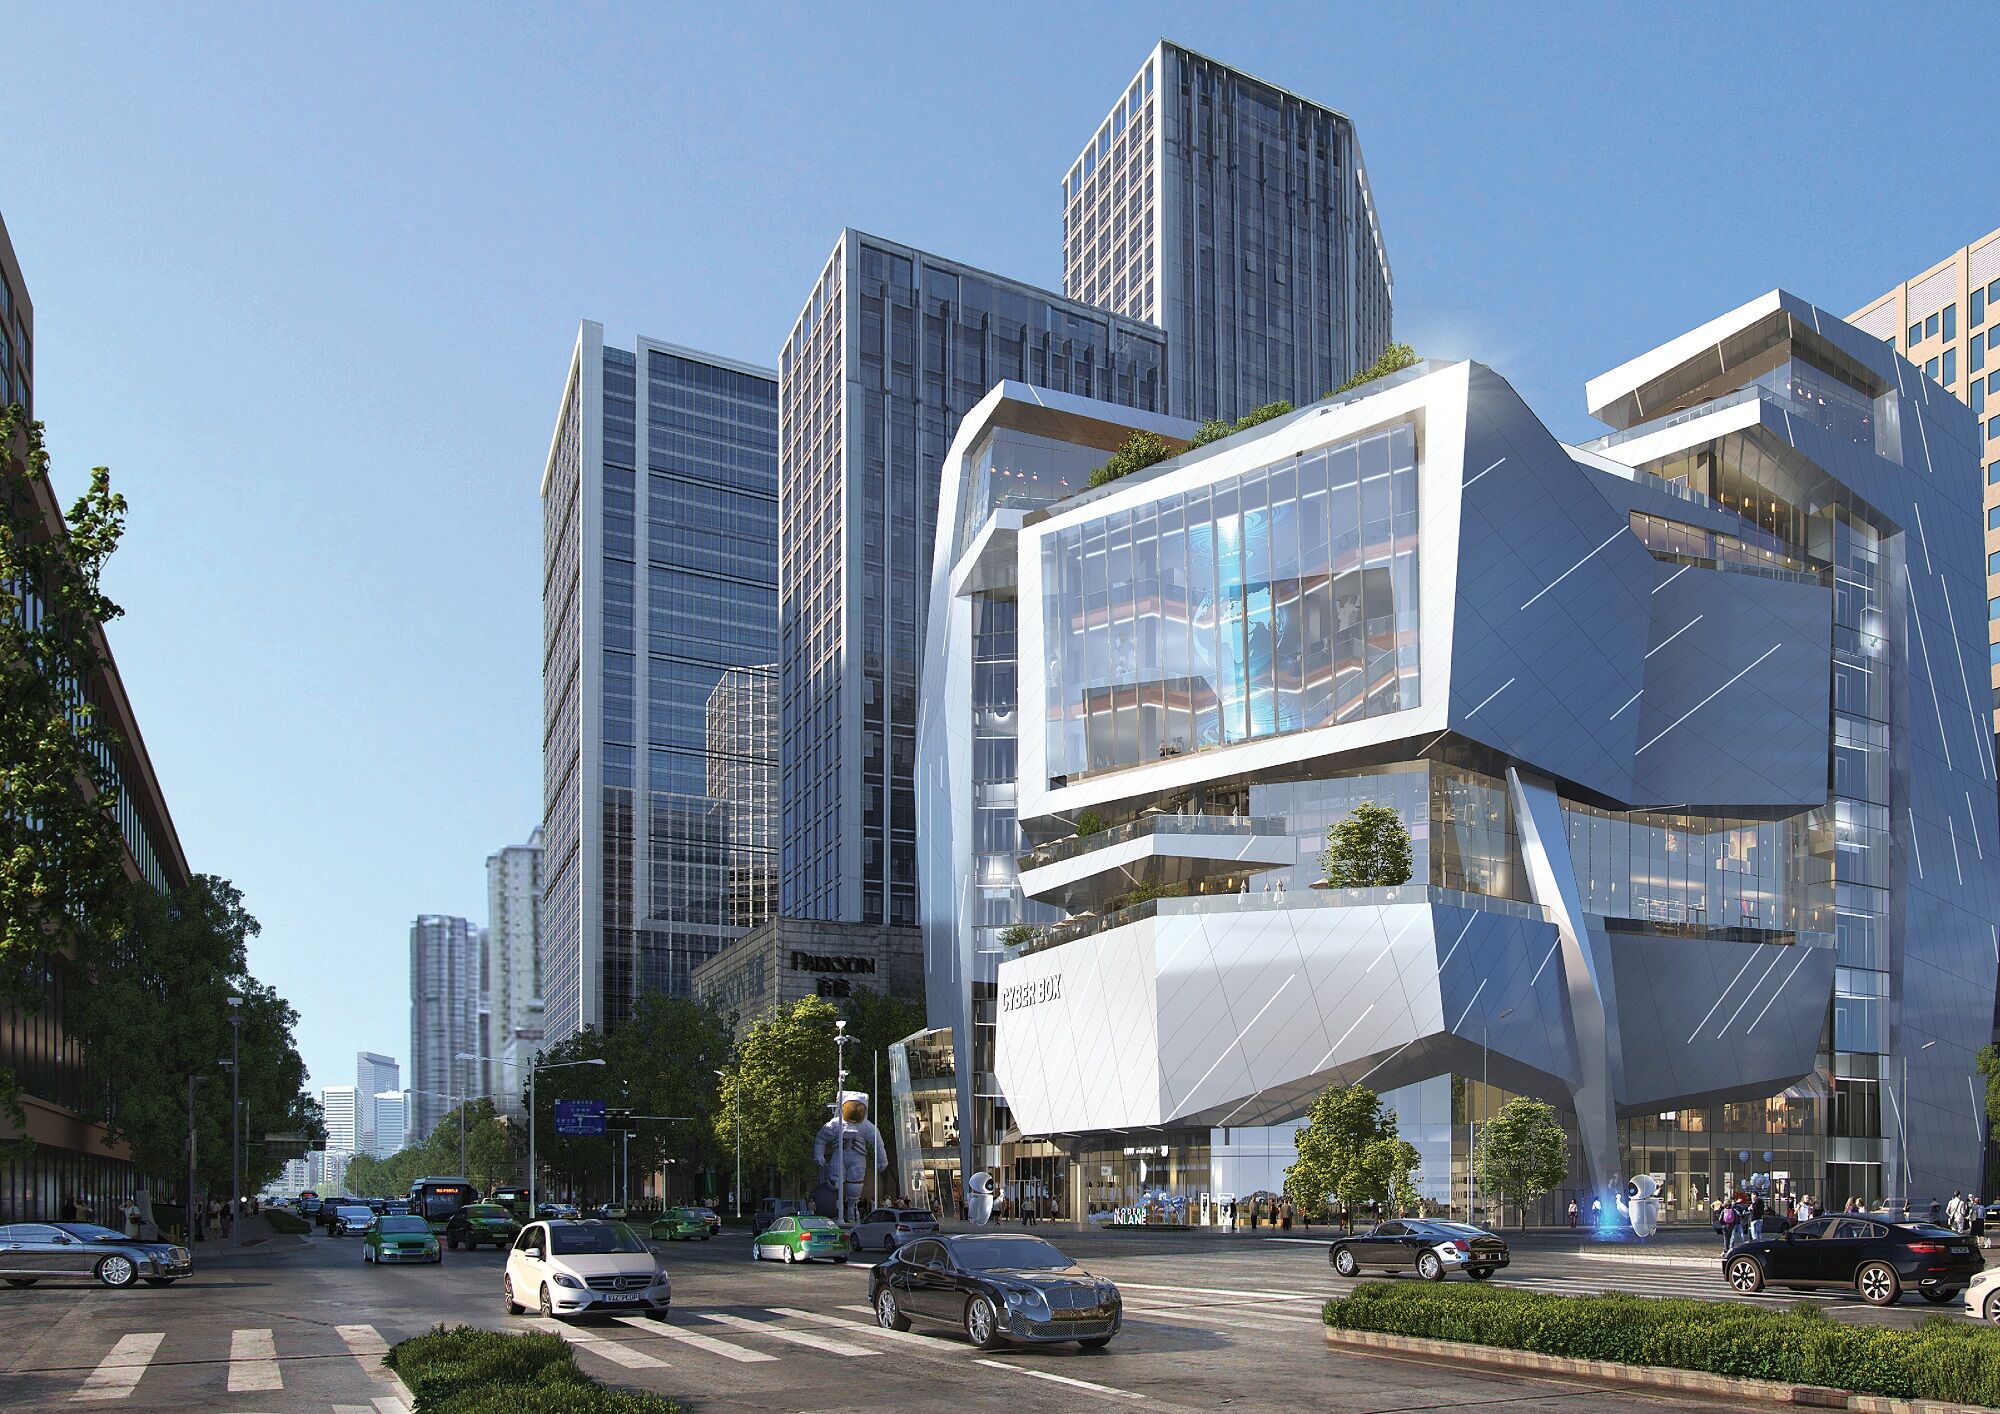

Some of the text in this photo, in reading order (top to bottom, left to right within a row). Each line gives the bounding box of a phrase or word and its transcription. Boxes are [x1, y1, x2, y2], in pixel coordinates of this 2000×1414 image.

[1002, 973, 1062, 1012] CYBER BOX
[1114, 1207, 1147, 1215] MODERN
[1113, 1215, 1147, 1225] INLANE
